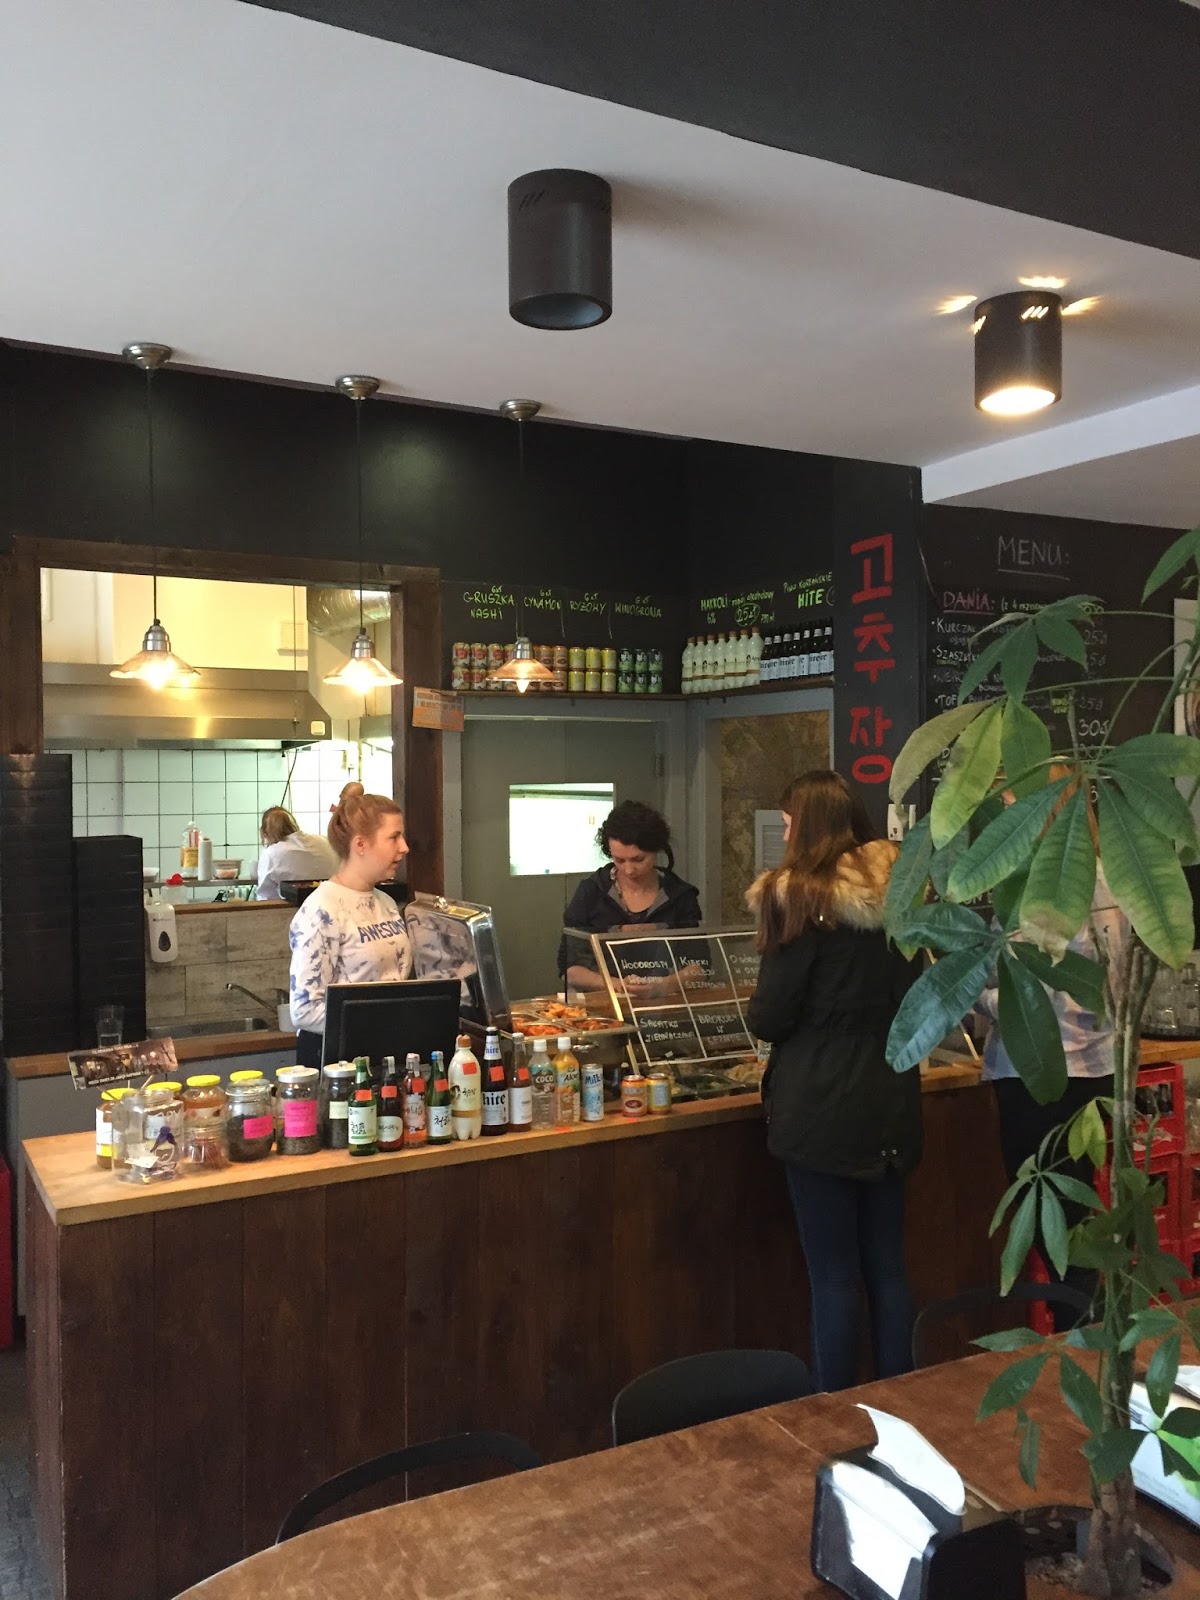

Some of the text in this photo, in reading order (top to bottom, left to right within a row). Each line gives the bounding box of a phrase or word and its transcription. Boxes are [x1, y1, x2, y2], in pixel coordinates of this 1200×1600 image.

[463, 591, 515, 606] GRUSZKA
[523, 596, 561, 611] CYNAMON
[849, 533, 897, 785] 고추장
[482, 1092, 506, 1106] hite
